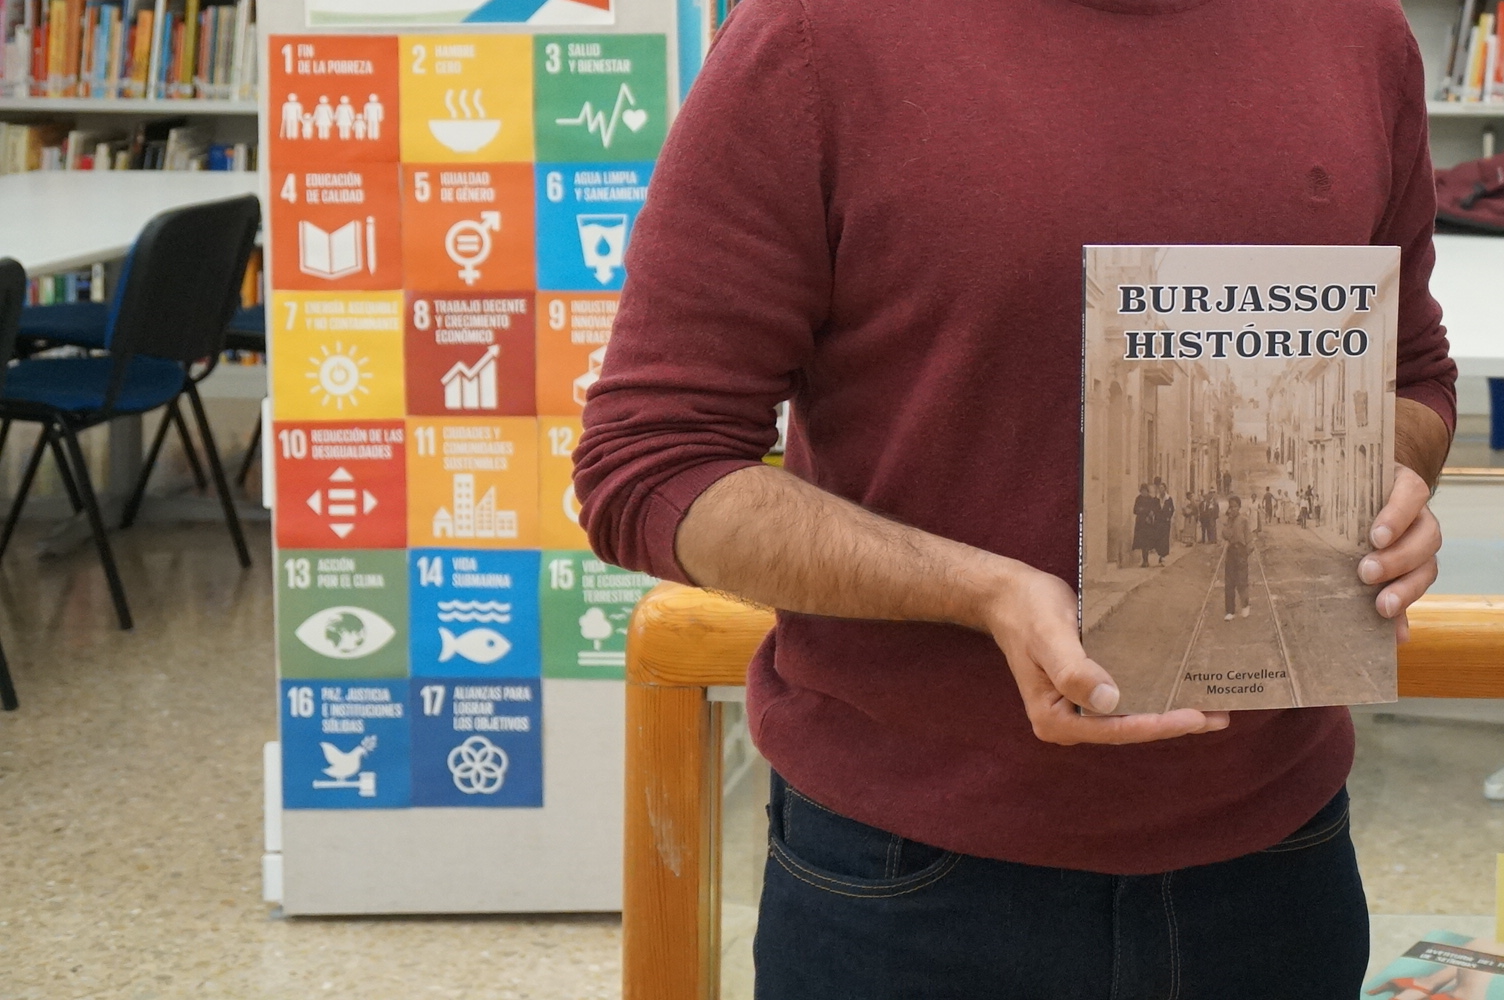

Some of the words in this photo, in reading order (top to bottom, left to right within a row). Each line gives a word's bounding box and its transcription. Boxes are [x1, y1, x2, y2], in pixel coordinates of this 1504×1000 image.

[298, 44, 314, 58] FIN
[435, 45, 474, 59] HAMBRE
[568, 44, 600, 58] SALUD
[281, 44, 293, 74] 1
[412, 44, 426, 74] 2
[546, 44, 560, 73] 3
[298, 61, 311, 74] DE
[313, 61, 326, 74] LA
[328, 60, 373, 74] POBREZA
[436, 60, 461, 74] CERO
[568, 60, 576, 74] Y
[578, 60, 630, 74] BIENESTAR
[306, 172, 361, 188] EDUCACIÓN
[440, 172, 490, 186] IGUALDAD
[574, 171, 601, 184] AGUA
[603, 171, 637, 184] LIMPIA
[281, 174, 296, 202] 4
[414, 173, 430, 202] 5
[441, 188, 454, 202] DE
[456, 185, 494, 202] GÉNERO
[546, 172, 562, 202] 6
[574, 187, 582, 201] Y
[306, 190, 320, 203] DE
[323, 189, 364, 203] CALIDAD
[1118, 284, 1376, 313] BURJASSOT
[304, 300, 344, 314] ENERGÍA
[348, 301, 398, 314] ASEQUIBLE
[434, 300, 481, 314] TRABAJO
[483, 299, 526, 313] DECENTE
[571, 300, 618, 314] INDUSTRI
[284, 301, 297, 330] 7
[414, 300, 430, 330] 8
[435, 315, 442, 328] Y
[445, 315, 510, 328] CRECIMIENTO
[549, 300, 564, 330] 9
[571, 314, 613, 328] INNOVAC
[436, 328, 492, 344] ECONÓMICO
[571, 330, 611, 345] INFRAES
[1124, 323, 1368, 360] HISTÓRICO
[311, 428, 366, 444] REDUCCIÓN
[369, 430, 382, 443] DE
[384, 430, 404, 443] LAS
[443, 426, 488, 440] CIUDADES
[491, 427, 500, 440] Y
[278, 430, 306, 459] 10
[414, 427, 435, 456] 11
[548, 426, 572, 456] 12
[312, 445, 392, 459] DESIGUALDADES
[443, 442, 514, 456] COMUNIDADES
[443, 457, 508, 471] SOSTENIBLES
[317, 557, 355, 573] ACCIÓN
[417, 557, 443, 586] 14
[452, 558, 477, 572] VIDA
[582, 560, 606, 572] VIDA
[284, 558, 310, 588] 13
[549, 560, 574, 589] 15
[318, 575, 338, 588] POR
[341, 575, 352, 588] EL
[354, 574, 384, 588] CLIMA
[452, 574, 510, 588] SUBMARINA
[582, 575, 594, 588] DE
[582, 590, 642, 603] TERRESTRES
[1184, 672, 1222, 682] Arturo
[1227, 670, 1286, 680] Cervellera
[346, 687, 390, 701] JUSTICIA
[453, 686, 501, 700] ALIANZAS
[503, 686, 530, 700] PARA
[1206, 683, 1264, 694] Moscardó
[288, 687, 314, 718] 16
[420, 686, 445, 716] 17
[322, 704, 328, 717] E
[330, 704, 403, 718] INSTITUCIONES
[453, 702, 494, 716] LOGRAR
[322, 718, 364, 734] SÓLIDAS
[453, 717, 472, 731] LOS
[474, 717, 530, 731] OBJETIVOS
